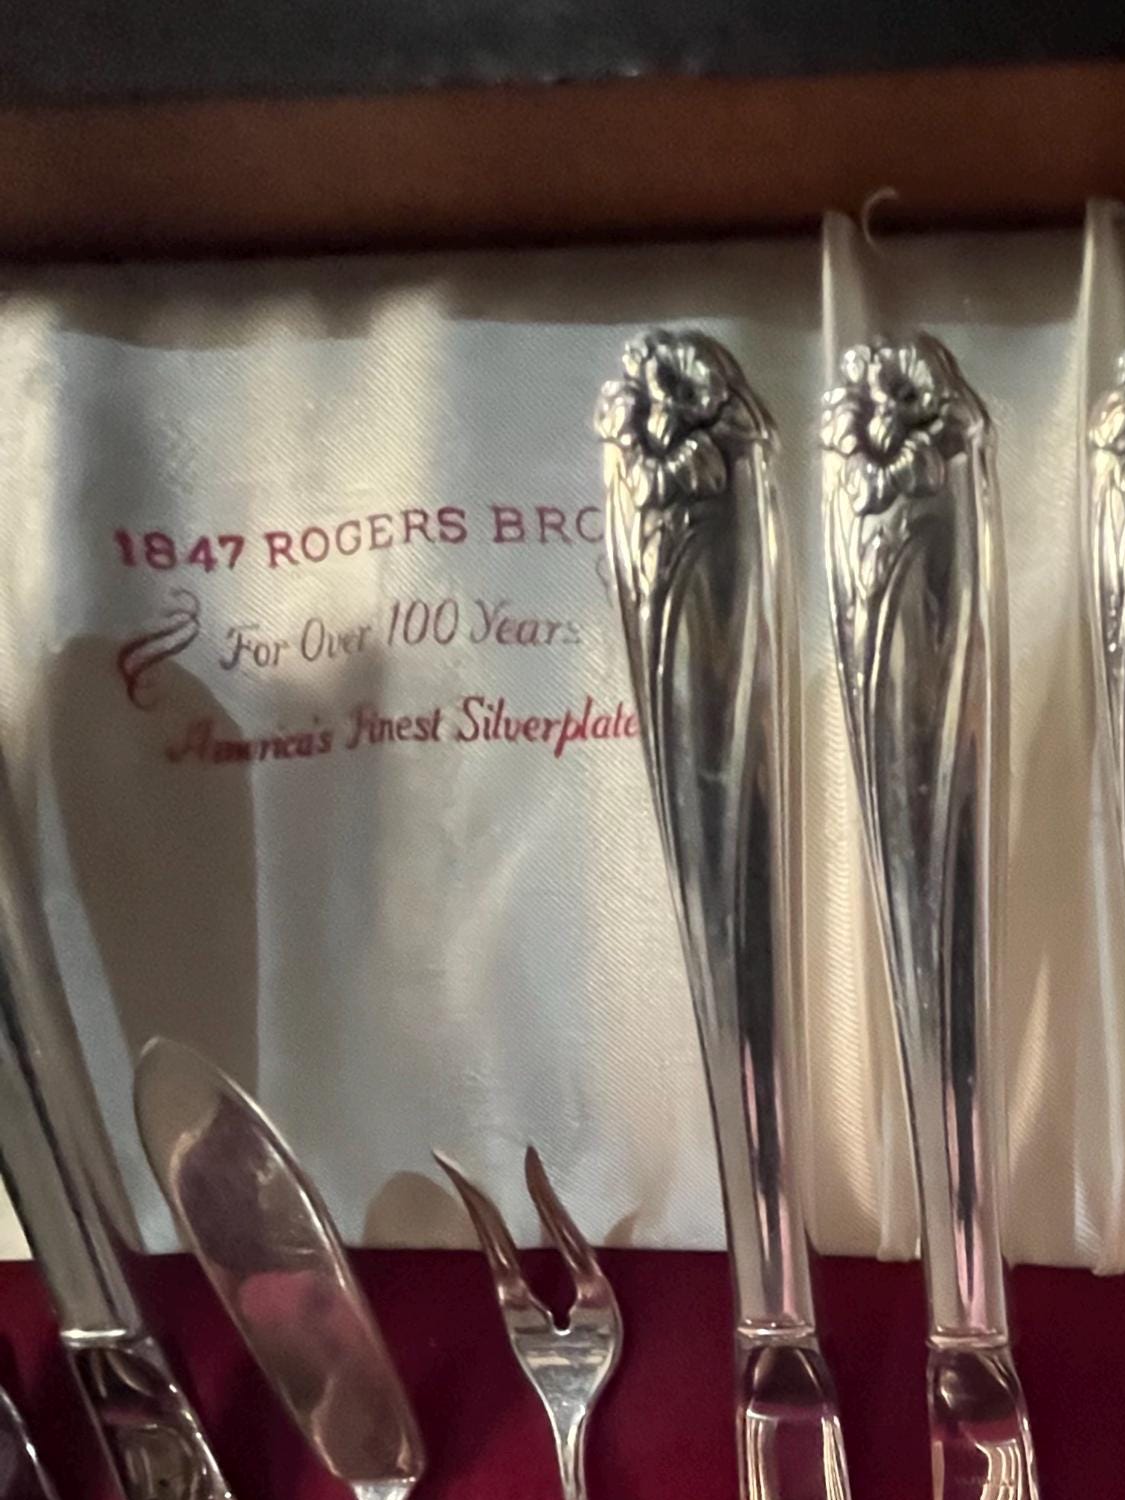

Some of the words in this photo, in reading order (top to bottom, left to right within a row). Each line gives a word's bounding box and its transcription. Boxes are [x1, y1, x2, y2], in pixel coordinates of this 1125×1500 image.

[113, 527, 246, 574] 1847
[263, 506, 468, 569] ROGERS
[217, 624, 290, 672] For
[301, 616, 373, 662] Over
[387, 598, 460, 646] 100
[470, 597, 581, 647] Years
[456, 693, 639, 759] Silverplate
